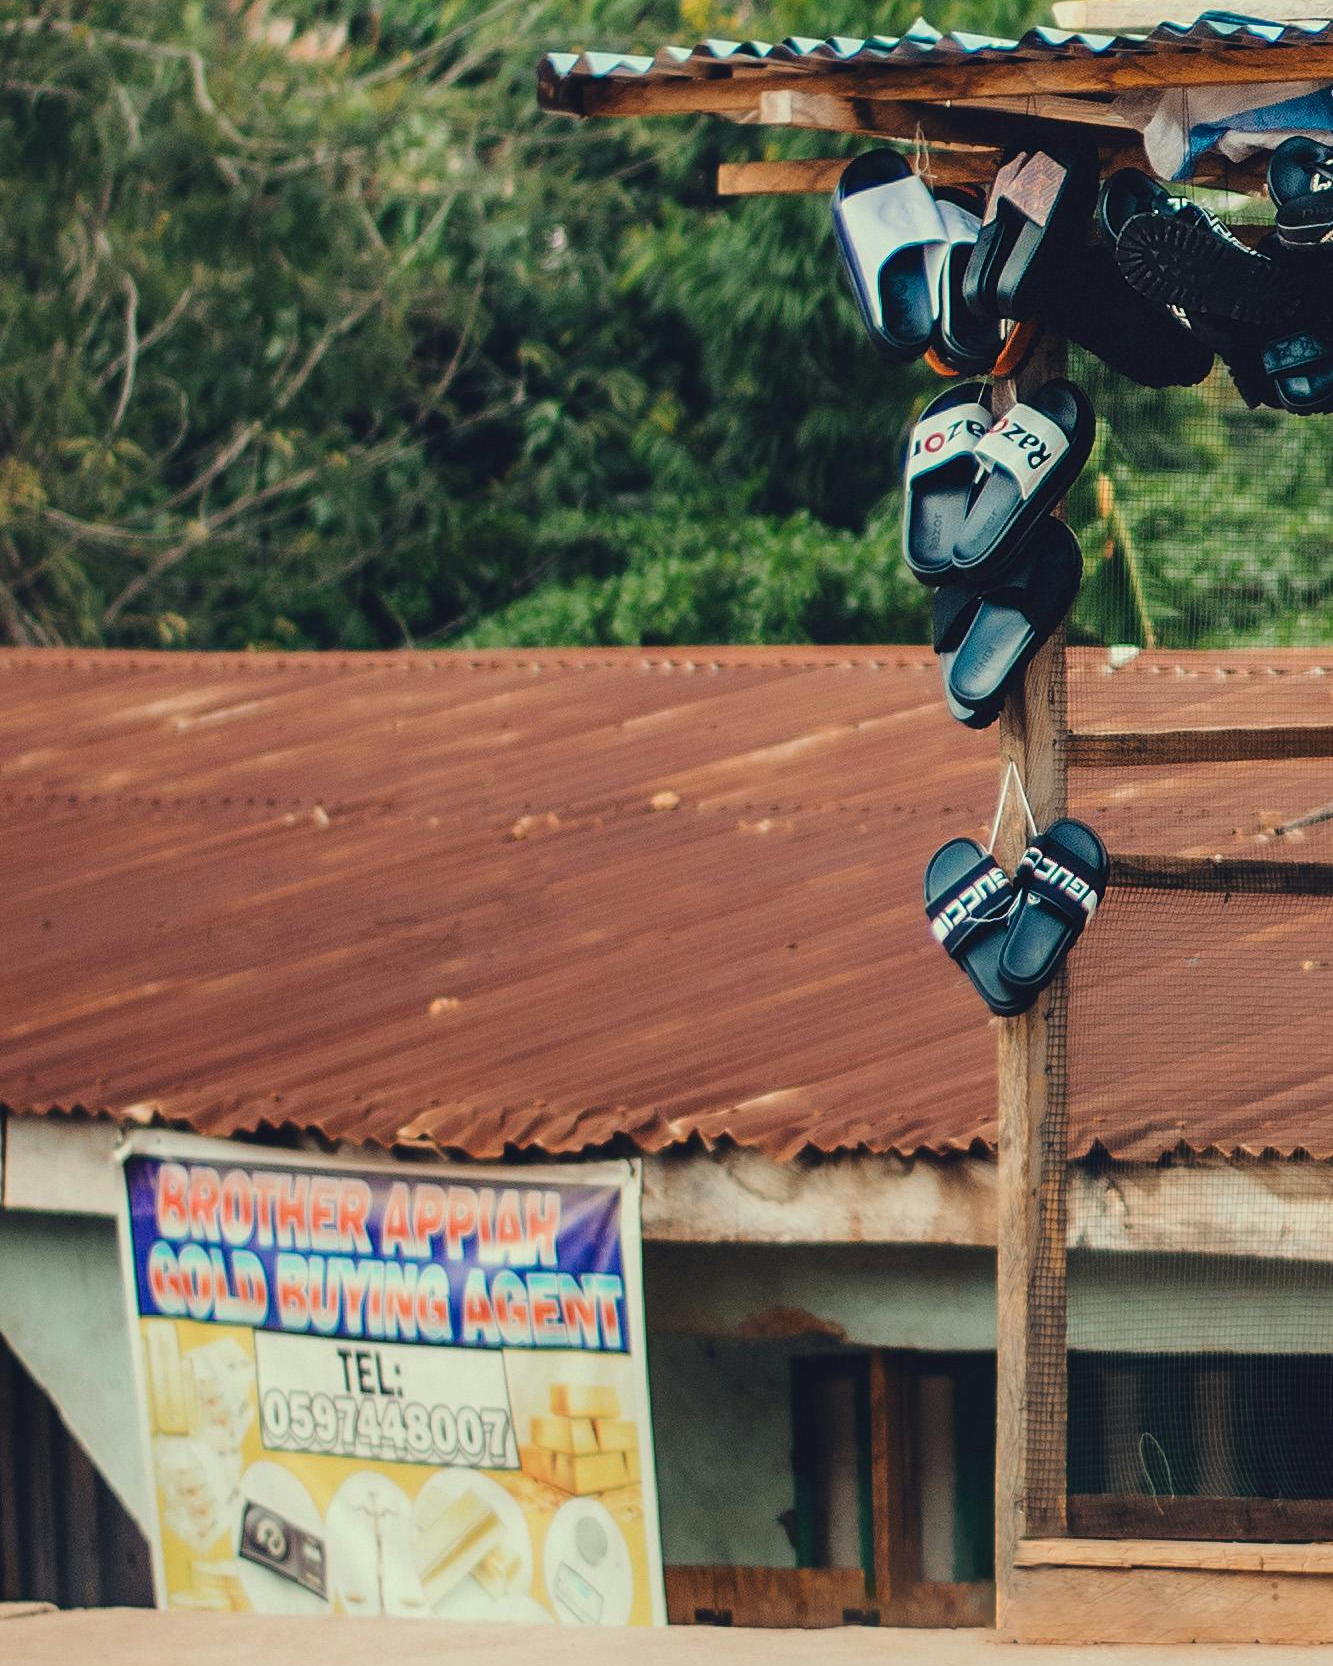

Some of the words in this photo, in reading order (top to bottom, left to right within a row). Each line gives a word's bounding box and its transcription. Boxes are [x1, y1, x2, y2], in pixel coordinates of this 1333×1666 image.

[157, 1162, 373, 1254] BROTHER
[382, 1181, 562, 1267] APPIAH
[148, 1239, 270, 1327] GOLD
[276, 1251, 453, 1341] BUYING
[462, 1266, 624, 1350] AGENT
[337, 1347, 404, 1398] TEL:
[263, 1388, 511, 1463] 0597448007
